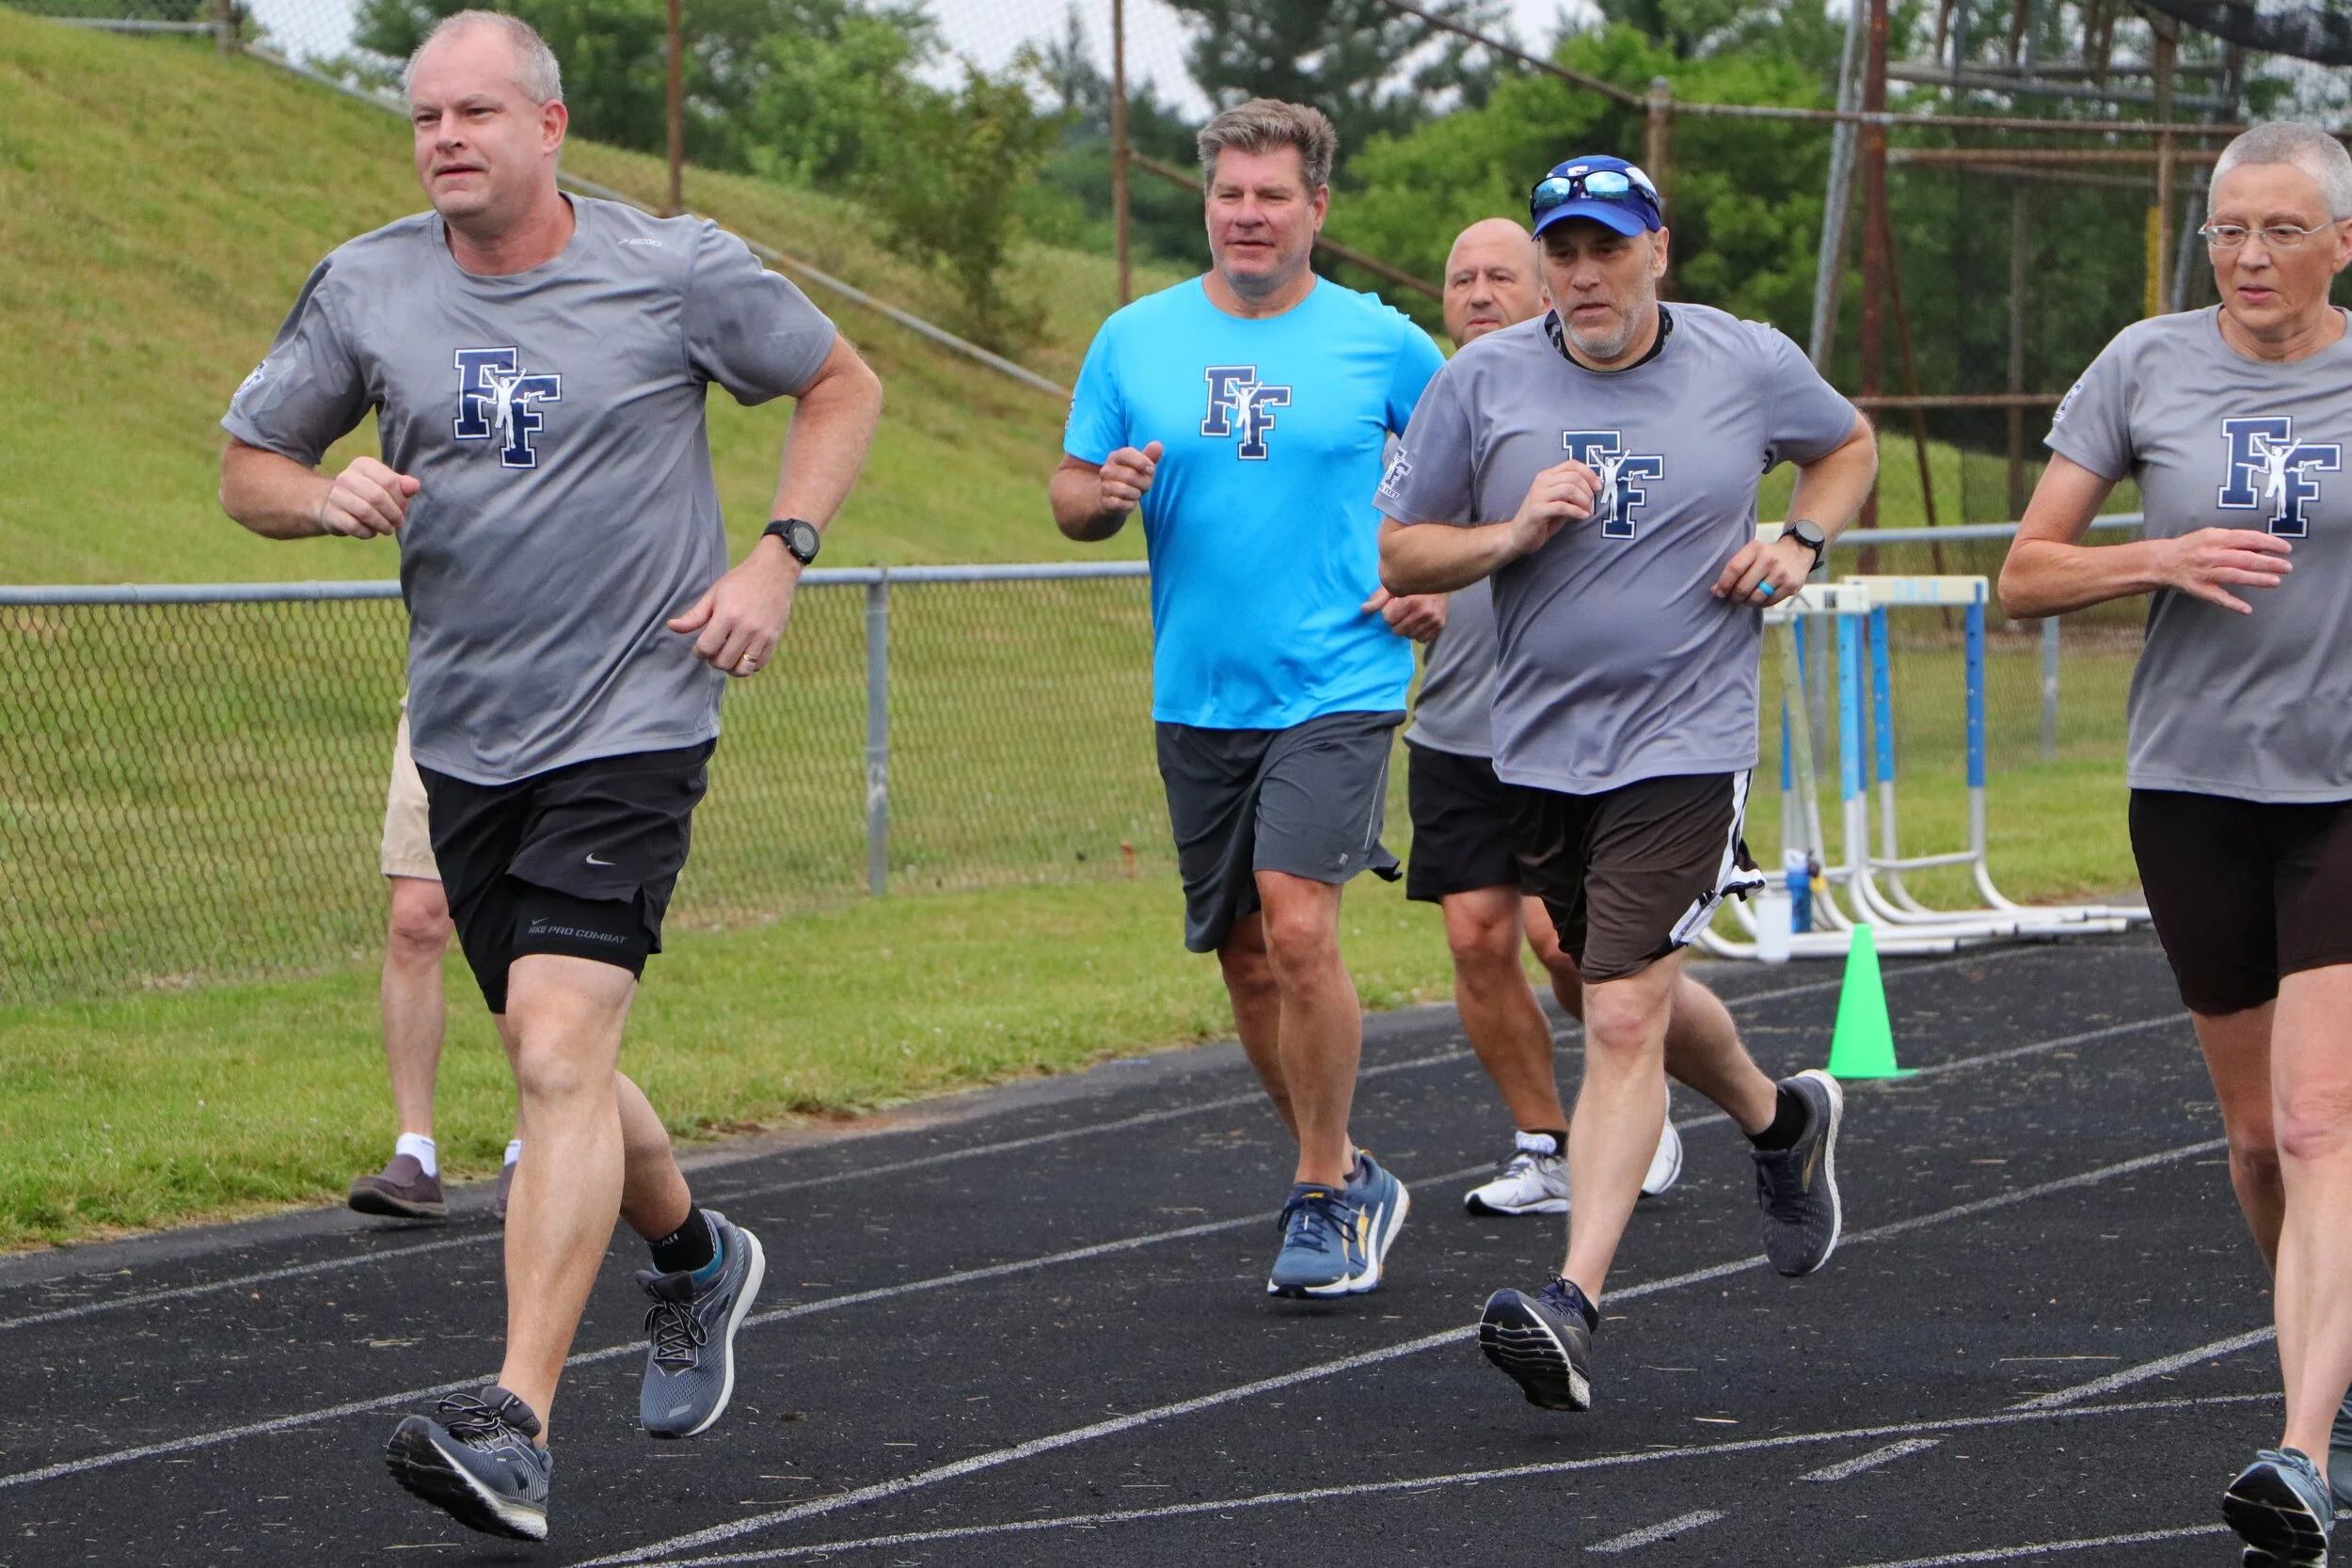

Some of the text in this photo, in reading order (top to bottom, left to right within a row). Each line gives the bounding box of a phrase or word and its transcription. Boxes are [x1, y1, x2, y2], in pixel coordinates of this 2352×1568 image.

[628, 237, 662, 247] BROOKS
[528, 925, 628, 944] NIKE PRO COMBAT
